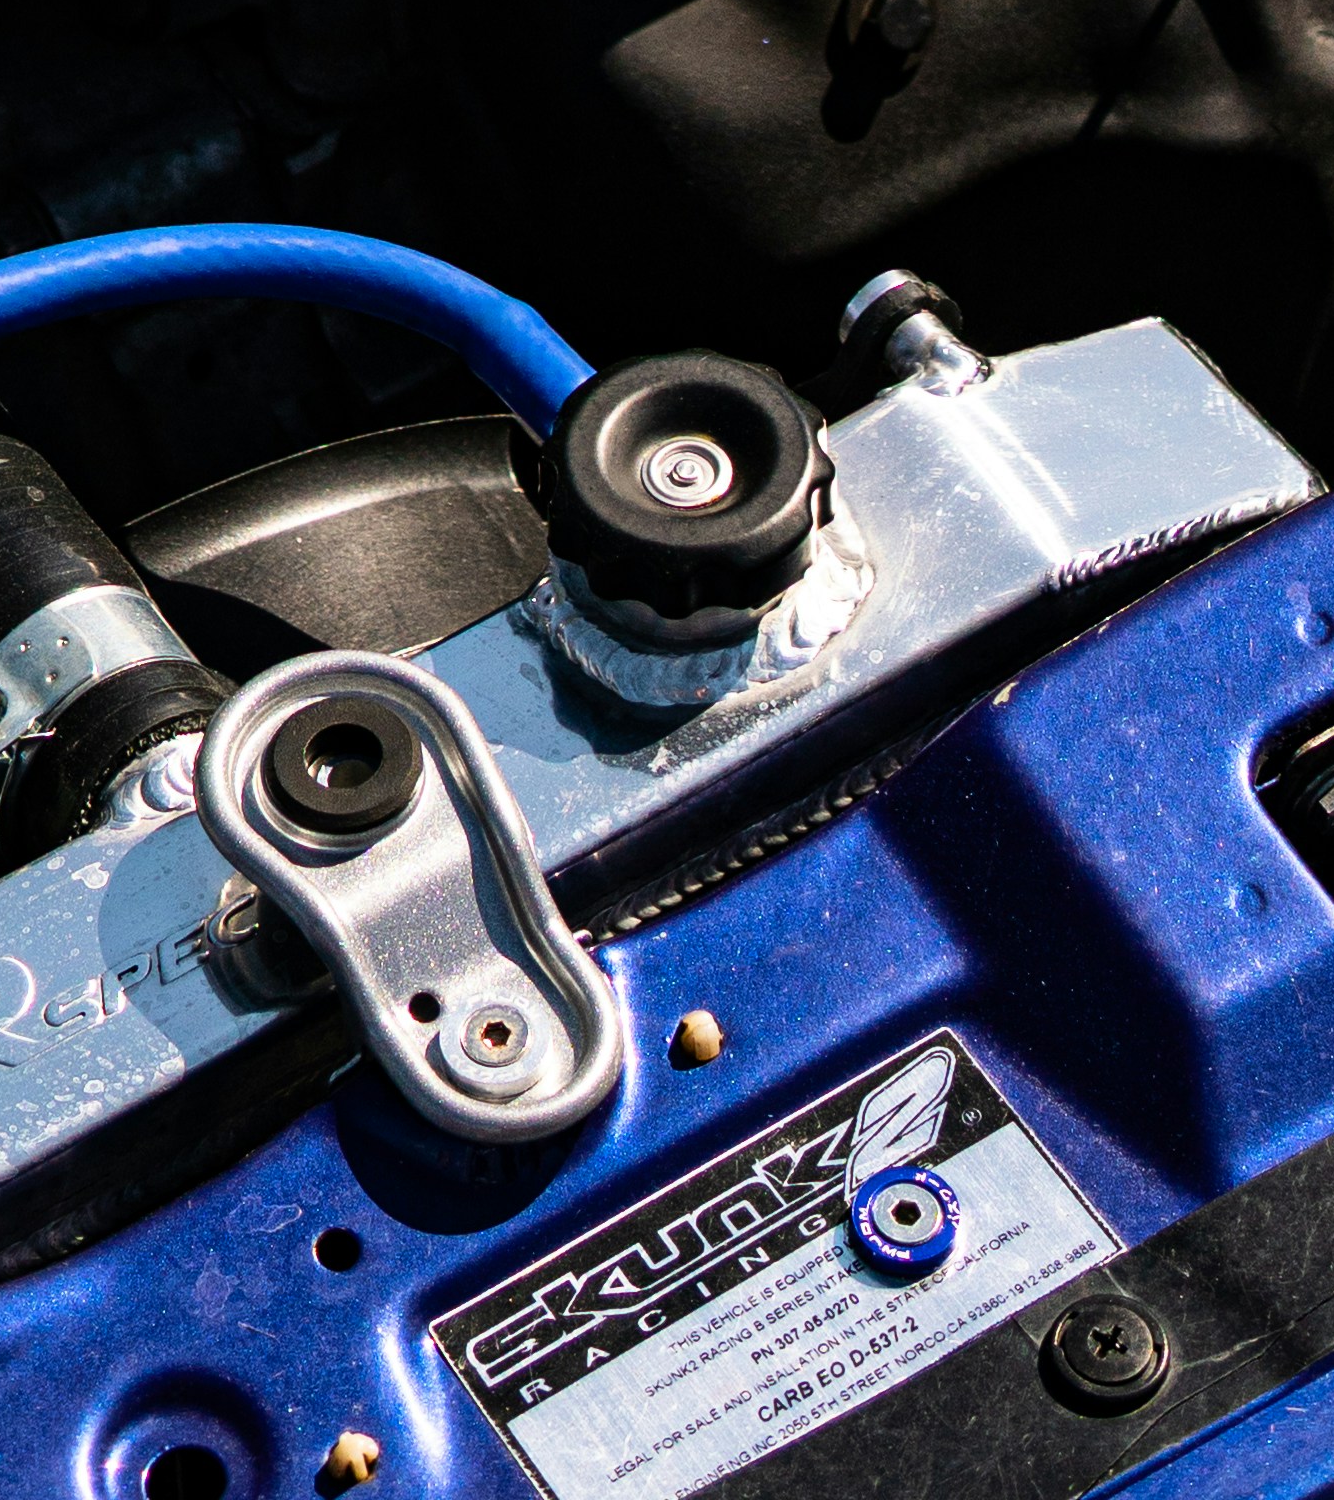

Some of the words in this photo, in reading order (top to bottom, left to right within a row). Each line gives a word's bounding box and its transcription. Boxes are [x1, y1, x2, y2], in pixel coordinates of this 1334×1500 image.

[466, 1045, 958, 1389] SKUNK2
[518, 1212, 828, 1404] RACING
[607, 1452, 653, 1482] LEGAL
[652, 1430, 684, 1454] FOR
[685, 1408, 721, 1435] SALE
[723, 1390, 752, 1413] AND
[753, 1336, 840, 1394] INSALLATION
[839, 1326, 856, 1339] IN
[855, 1308, 885, 1330] THE
[885, 1281, 930, 1312] STATE
[931, 1266, 953, 1285] OF
[956, 1220, 1031, 1272] CALIFORNIA
[644, 1359, 699, 1396] SKUNK2
[699, 1327, 752, 1364] RACING
[753, 1320, 765, 1331] B
[765, 1290, 814, 1324] SERIES
[816, 1260, 864, 1294] INTAKE
[668, 1330, 700, 1353] THIS
[700, 1295, 759, 1334] VEHICLE
[759, 1287, 774, 1300] IS
[775, 1242, 845, 1291] EQUIPPED
[750, 1344, 774, 1364] PN
[757, 1380, 813, 1422] CARB
[815, 1361, 845, 1388] EO
[848, 1316, 918, 1367] D-537-2
[810, 1397, 839, 1419] 5TH
[839, 1362, 891, 1401] STREET
